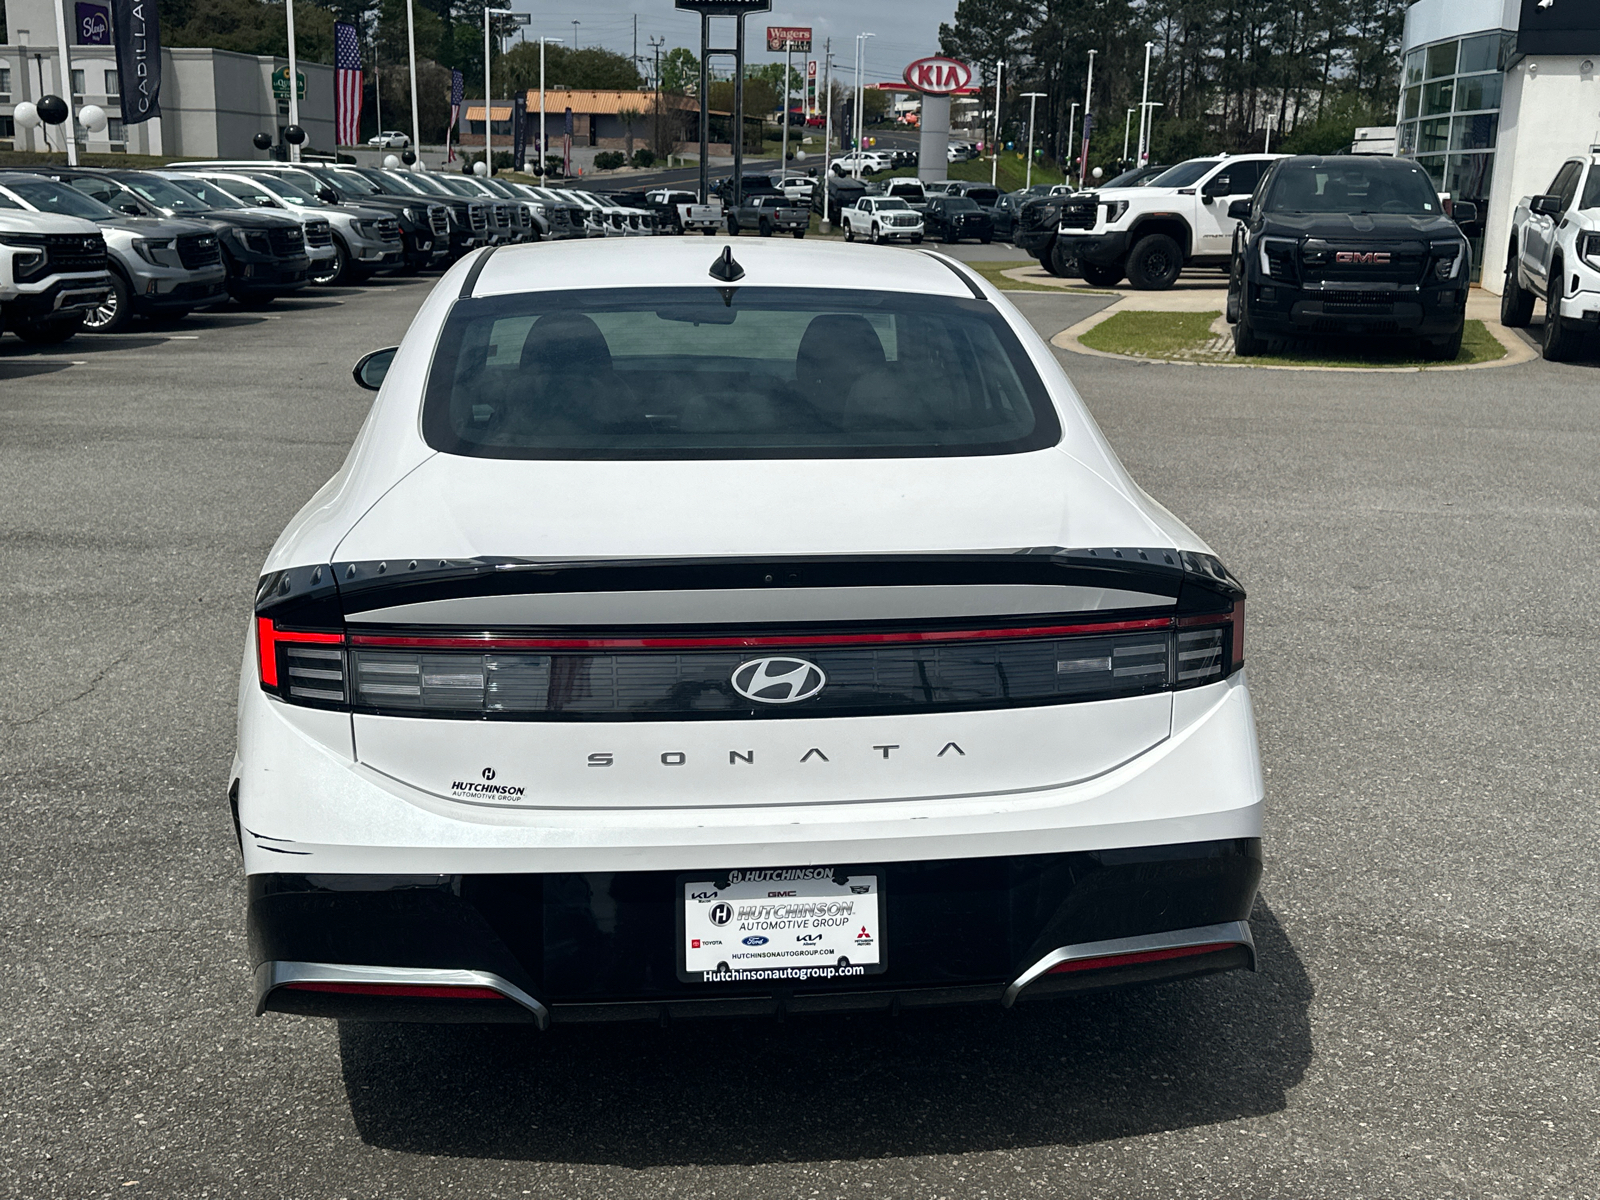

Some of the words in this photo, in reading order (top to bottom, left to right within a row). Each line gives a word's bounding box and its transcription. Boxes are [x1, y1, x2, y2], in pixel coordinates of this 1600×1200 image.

[83, 16, 106, 38] Sleep
[769, 28, 810, 40] Wagers
[132, 0, 149, 113] CADILLA
[917, 64, 961, 87] KIA
[1336, 251, 1391, 264] GMC
[587, 741, 966, 767] SONATA
[451, 781, 525, 796] HUTCHINSON
[452, 791, 496, 800] AUTOMOTIVE
[497, 793, 522, 802] GROUP
[744, 868, 834, 882] HUTCHINSON
[767, 890, 797, 898] GMC
[736, 901, 855, 921] HUTCHINSON
[739, 920, 809, 931] AUTOMOTIVE
[812, 917, 850, 929] GROUP
[732, 949, 835, 959] HUTCHINSONAUTOGROUP.COM
[703, 966, 864, 982] Hutchinsonautogroup.com
